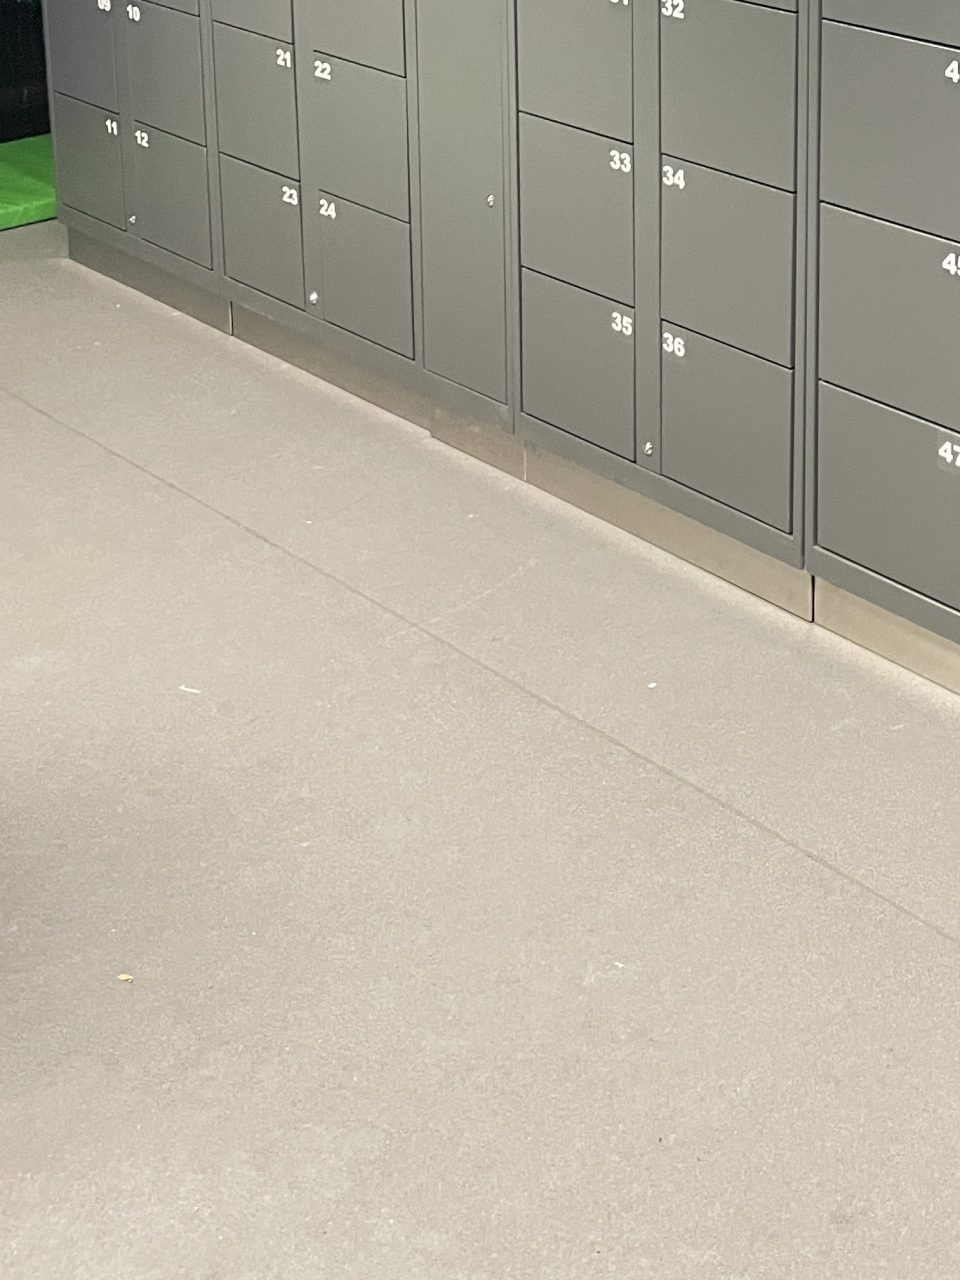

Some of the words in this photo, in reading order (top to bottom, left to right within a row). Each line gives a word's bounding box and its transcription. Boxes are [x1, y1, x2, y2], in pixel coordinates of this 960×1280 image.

[126, 4, 141, 22] 10
[275, 48, 292, 68] 21
[313, 60, 332, 81] 22
[105, 119, 118, 136] 11
[134, 130, 149, 148] 12
[609, 149, 632, 173] 33
[662, 165, 686, 190] 34
[281, 186, 299, 206] 23
[319, 198, 337, 219] 24
[611, 311, 633, 336] 35
[662, 331, 686, 357] 36
